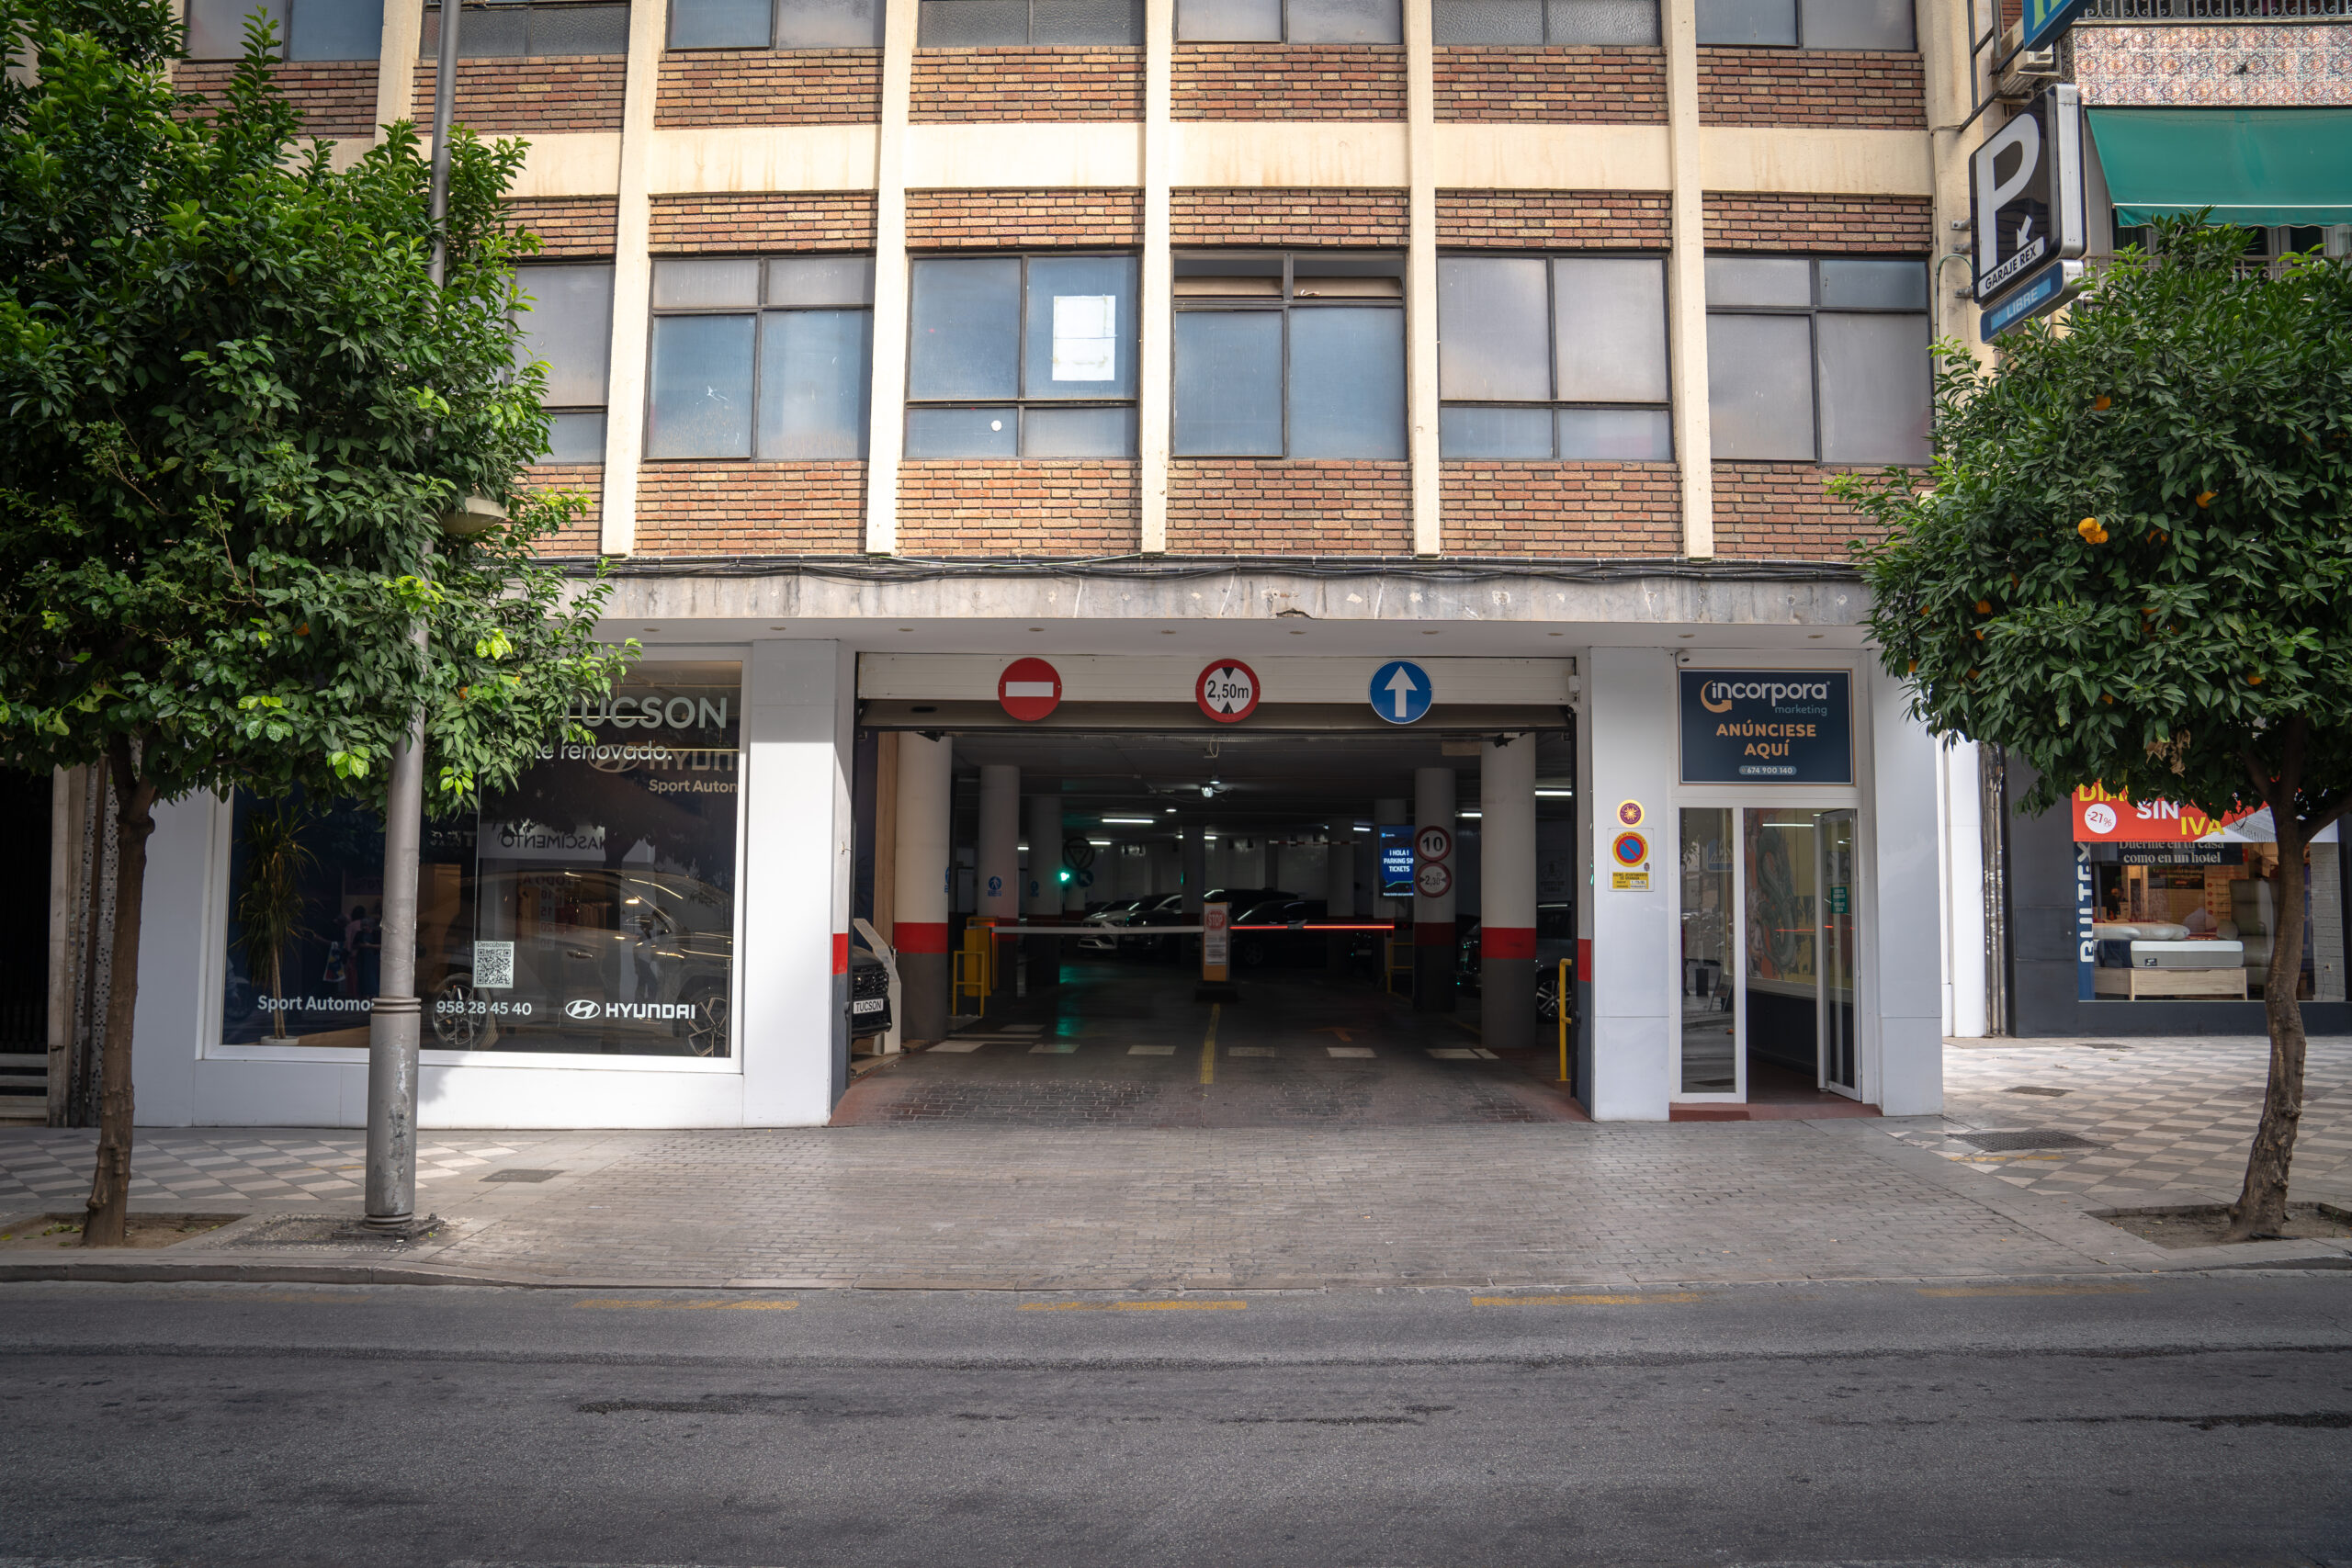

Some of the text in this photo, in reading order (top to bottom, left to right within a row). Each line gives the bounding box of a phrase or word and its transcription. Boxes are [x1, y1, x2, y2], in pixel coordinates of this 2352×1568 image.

[1976, 113, 2040, 274] P
[1985, 244, 2037, 289] GARAJE REX
[2007, 287, 2038, 319] LIBRE
[1207, 680, 1250, 702] 2,50m
[1712, 682, 1827, 706] incorpora
[1774, 705, 1827, 716] marketing
[1716, 719, 1816, 737] ANÚNCIESE
[560, 740, 673, 761] renovado.
[1744, 739, 1790, 759] AQUÍ
[649, 749, 738, 771] HYUN
[648, 778, 690, 795] Sport
[2136, 799, 2179, 819] SIN
[2087, 811, 2112, 827] -21%
[2180, 816, 2225, 835] IVA
[1422, 836, 1443, 852] 10
[2123, 852, 2222, 863] como en un hotel
[1208, 915, 1223, 927] STOP
[257, 995, 374, 1013] Sport Automo
[436, 1000, 532, 1016] 958 28 45 40
[605, 1002, 695, 1020] HYUNDAI
[856, 999, 882, 1012] TUCSON
